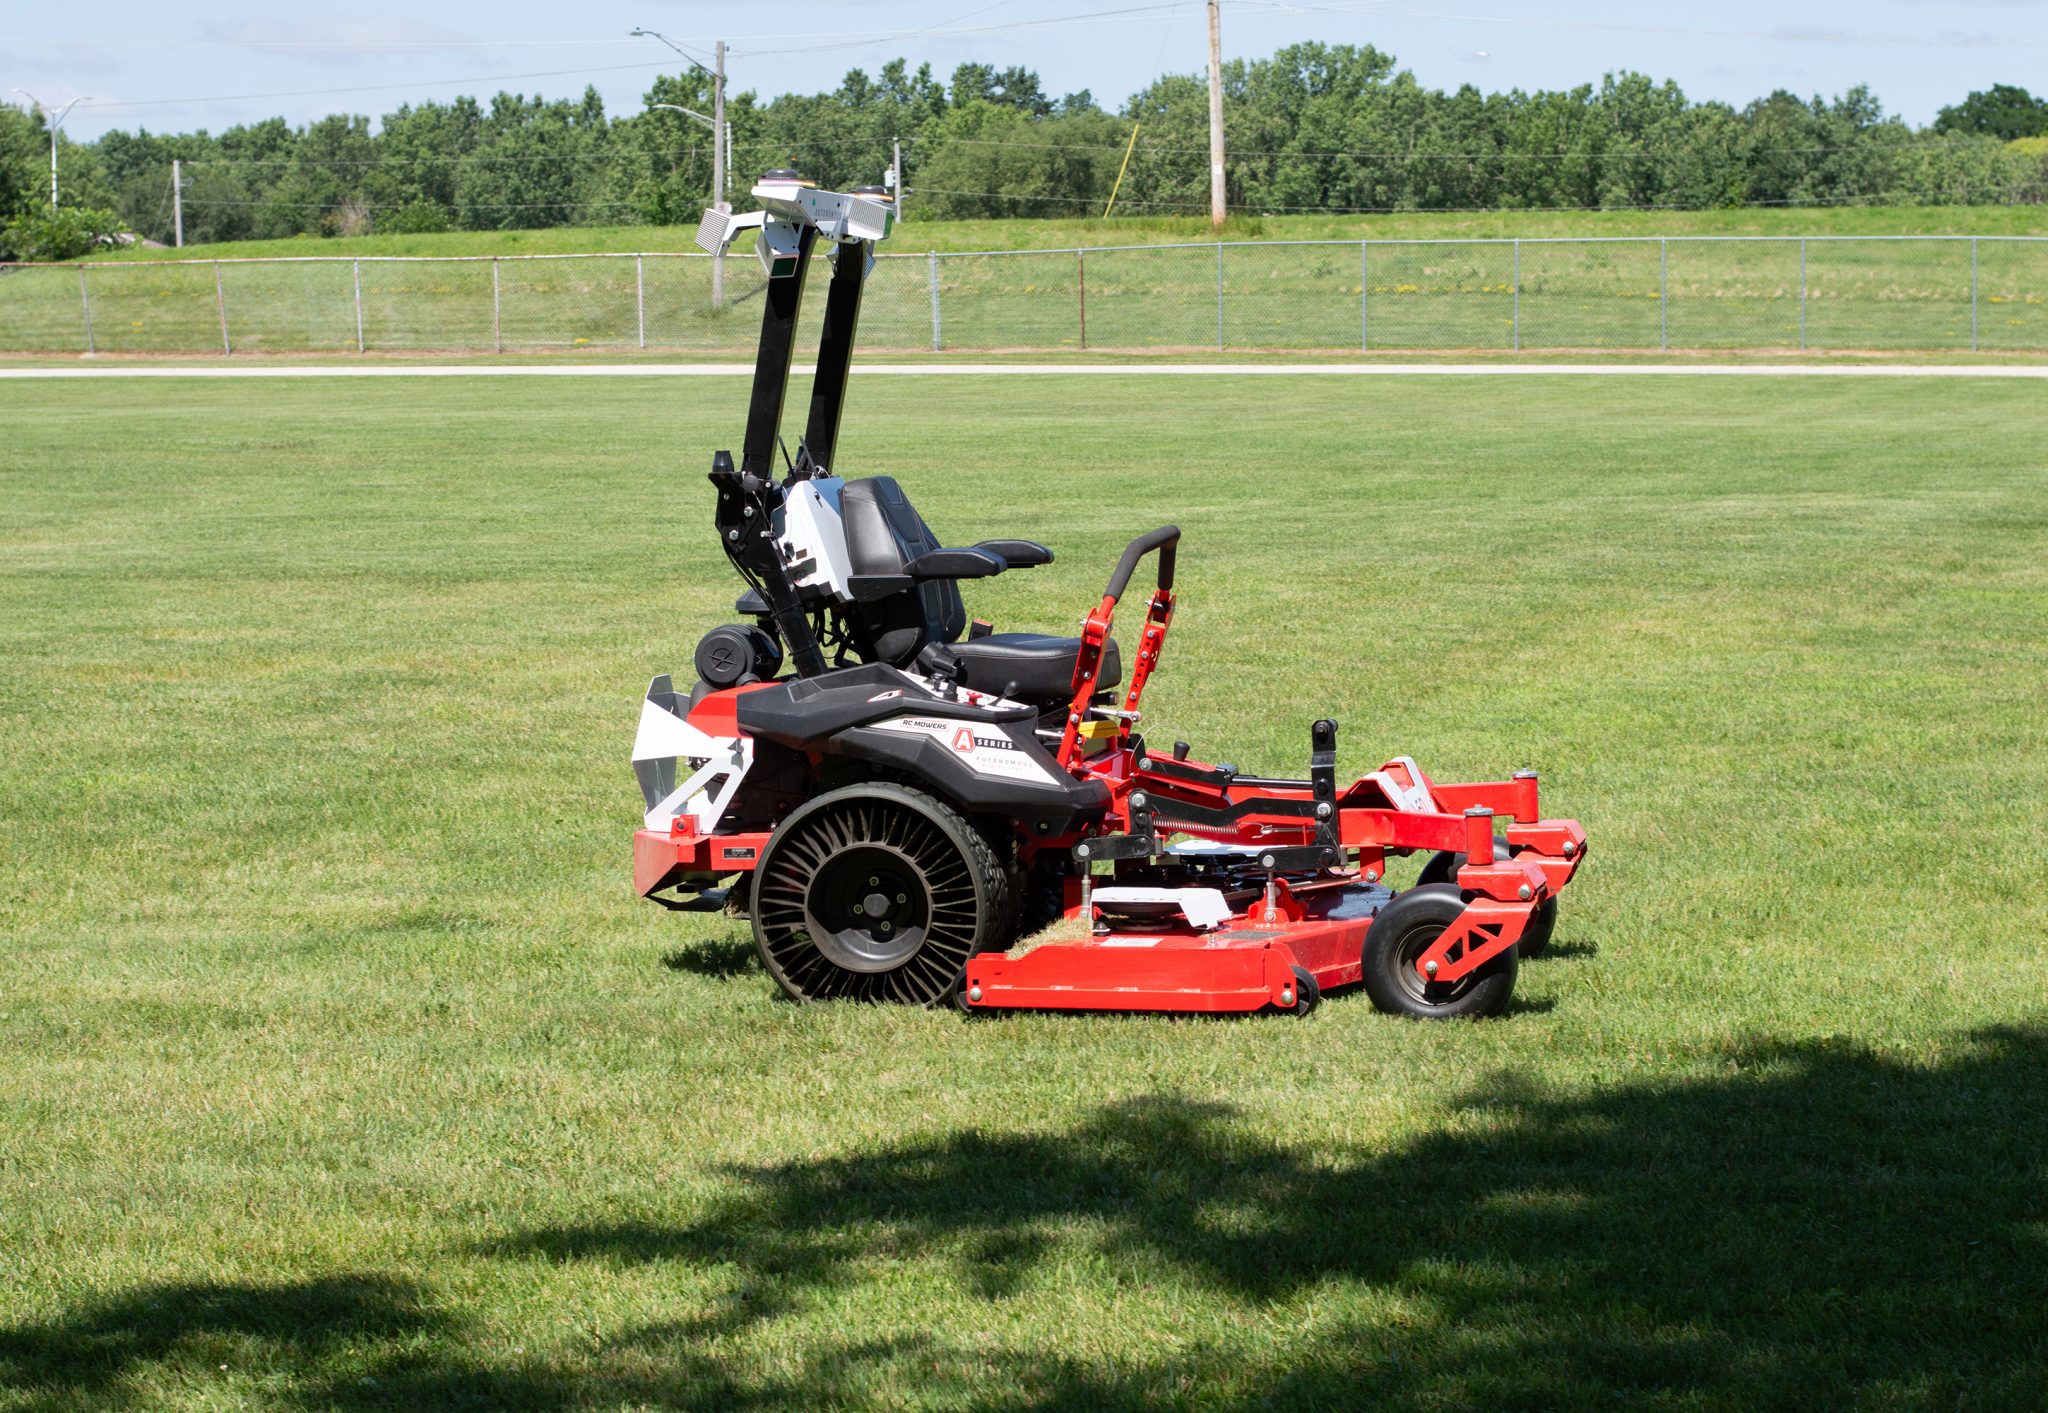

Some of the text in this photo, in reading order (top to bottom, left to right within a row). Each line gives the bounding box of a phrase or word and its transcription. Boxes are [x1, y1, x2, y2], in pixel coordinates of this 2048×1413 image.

[914, 720, 947, 730] MOWERS
[956, 731, 1013, 750] A SERIES
[975, 756, 1033, 768] AUTONOMOUS
